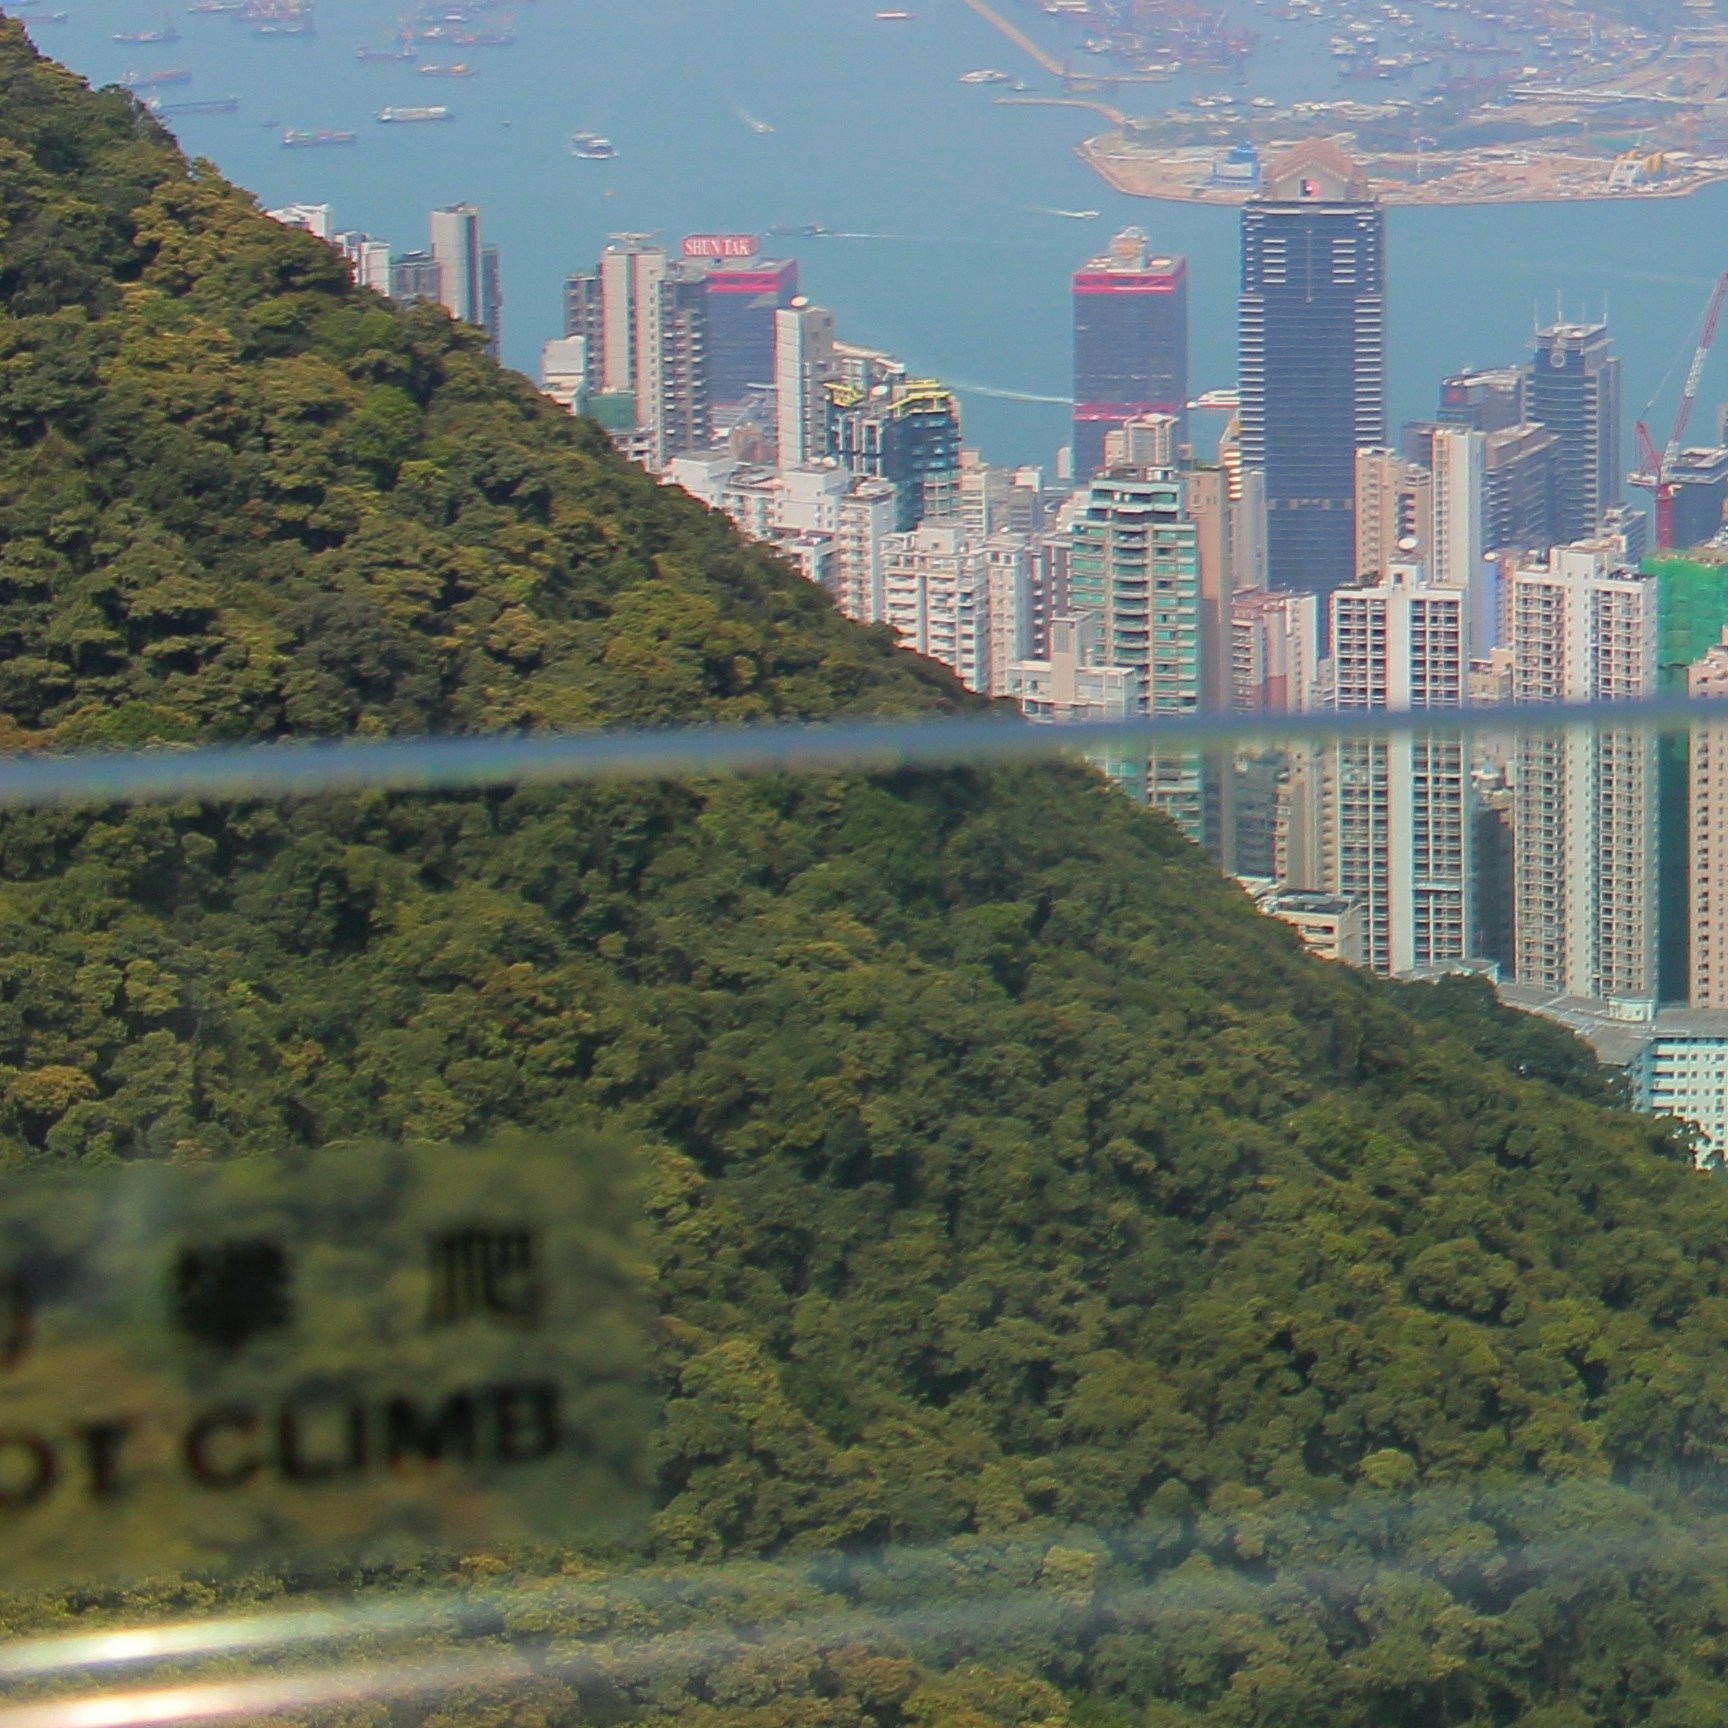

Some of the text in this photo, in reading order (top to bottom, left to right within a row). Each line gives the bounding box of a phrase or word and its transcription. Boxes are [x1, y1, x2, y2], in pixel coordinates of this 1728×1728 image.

[685, 239, 749, 255] SHUN TAK
[186, 1383, 561, 1489] CLIMB
